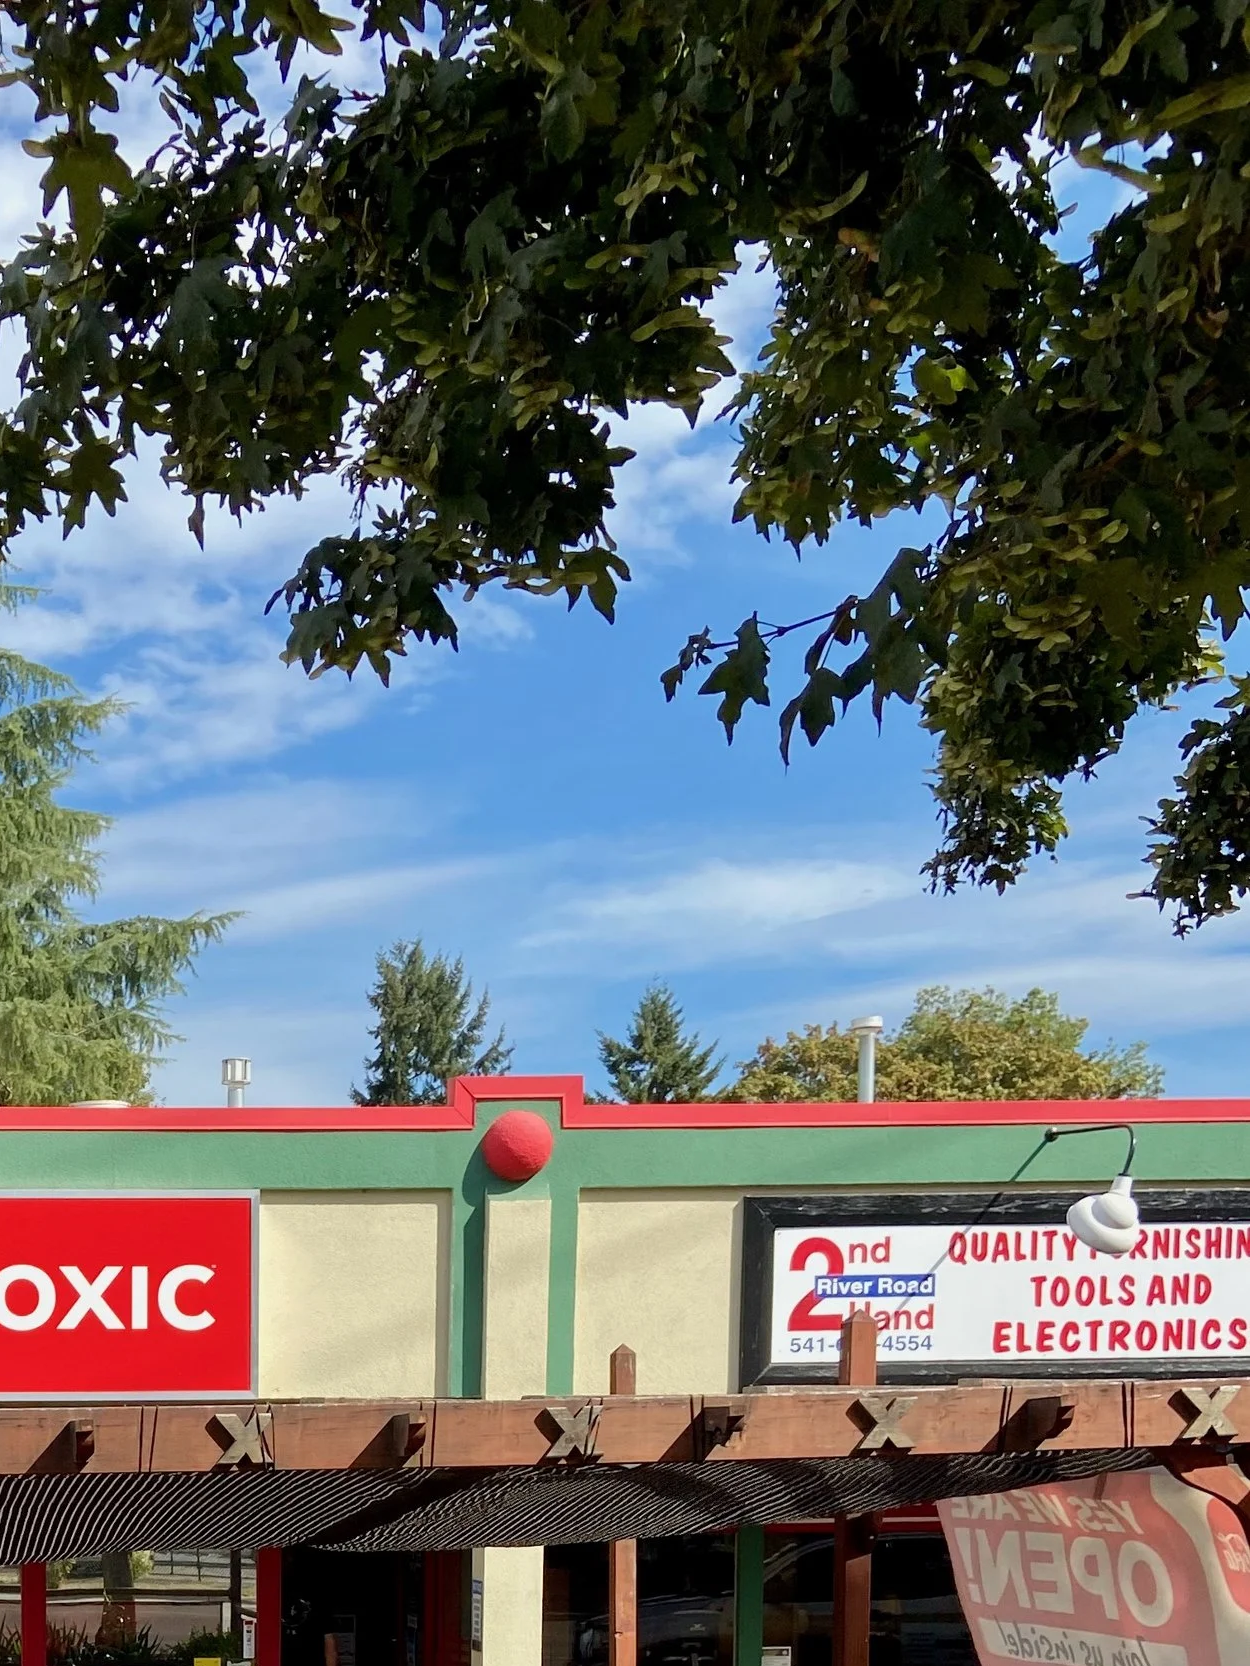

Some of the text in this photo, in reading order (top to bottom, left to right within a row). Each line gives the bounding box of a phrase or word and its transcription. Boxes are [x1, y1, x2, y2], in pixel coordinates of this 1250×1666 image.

[949, 1227, 1250, 1265] QUALITY RNISHIN
[816, 1276, 933, 1295] River Road
[1030, 1273, 1212, 1307] TOOLS AND
[992, 1318, 1248, 1353] ELECTRONICS
